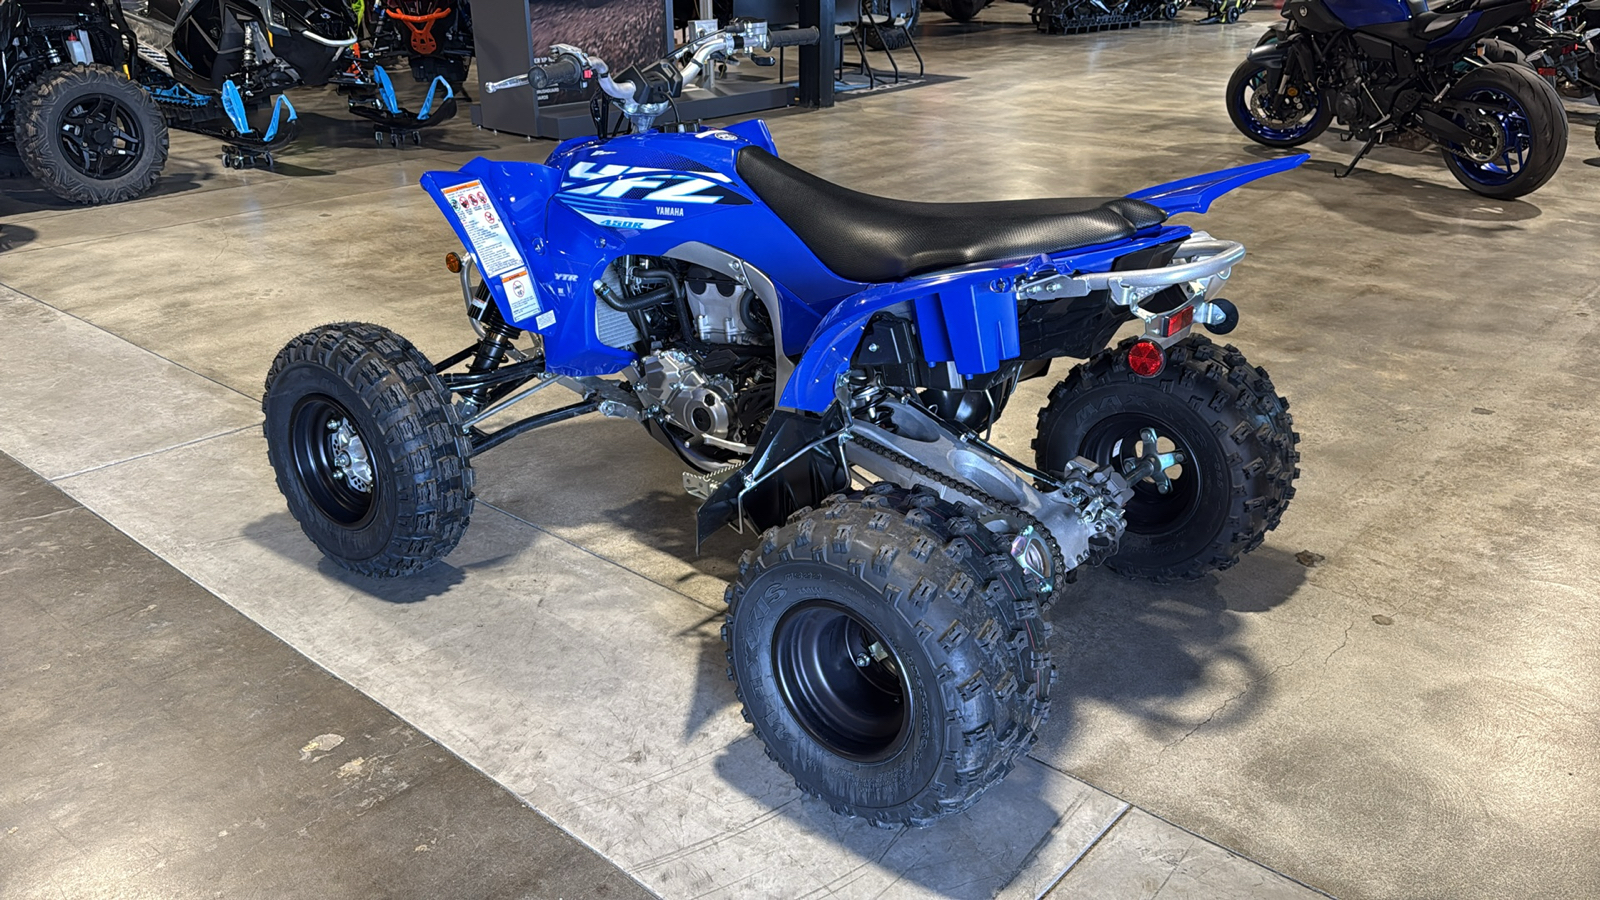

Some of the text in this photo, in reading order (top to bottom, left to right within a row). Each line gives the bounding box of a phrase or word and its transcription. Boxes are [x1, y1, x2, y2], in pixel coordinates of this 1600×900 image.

[561, 161, 733, 205] YFZ
[656, 206, 684, 217] YAMAHA
[600, 219, 644, 229] 450R
[554, 272, 579, 282] YTR
